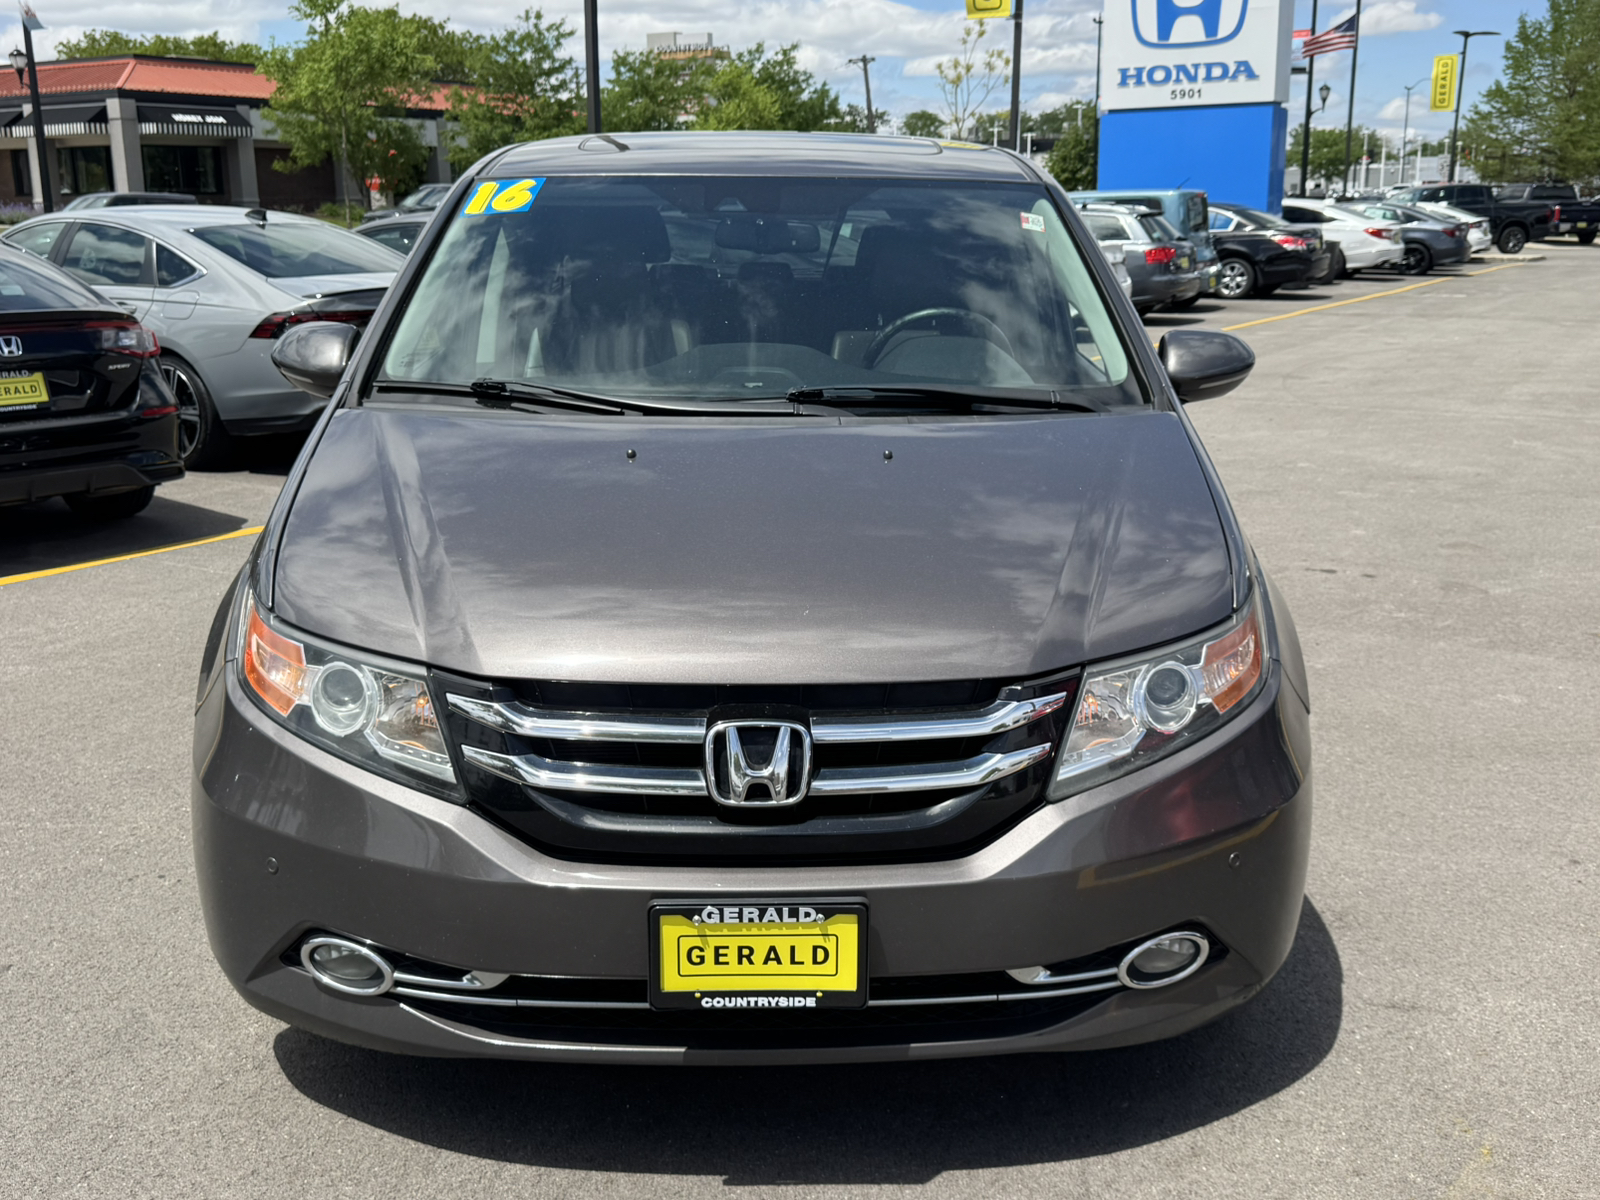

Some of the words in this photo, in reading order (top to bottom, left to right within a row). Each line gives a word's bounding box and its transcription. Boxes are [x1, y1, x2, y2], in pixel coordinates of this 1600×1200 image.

[1117, 60, 1260, 88] HONDA
[1438, 61, 1449, 105] GERALD
[1170, 88, 1202, 100] 5901
[464, 179, 536, 214] 16
[0, 370, 29, 378] RALD
[701, 907, 817, 924] GERALD
[686, 945, 830, 966] GERALD
[701, 997, 817, 1008] COUNTRYSIDE
